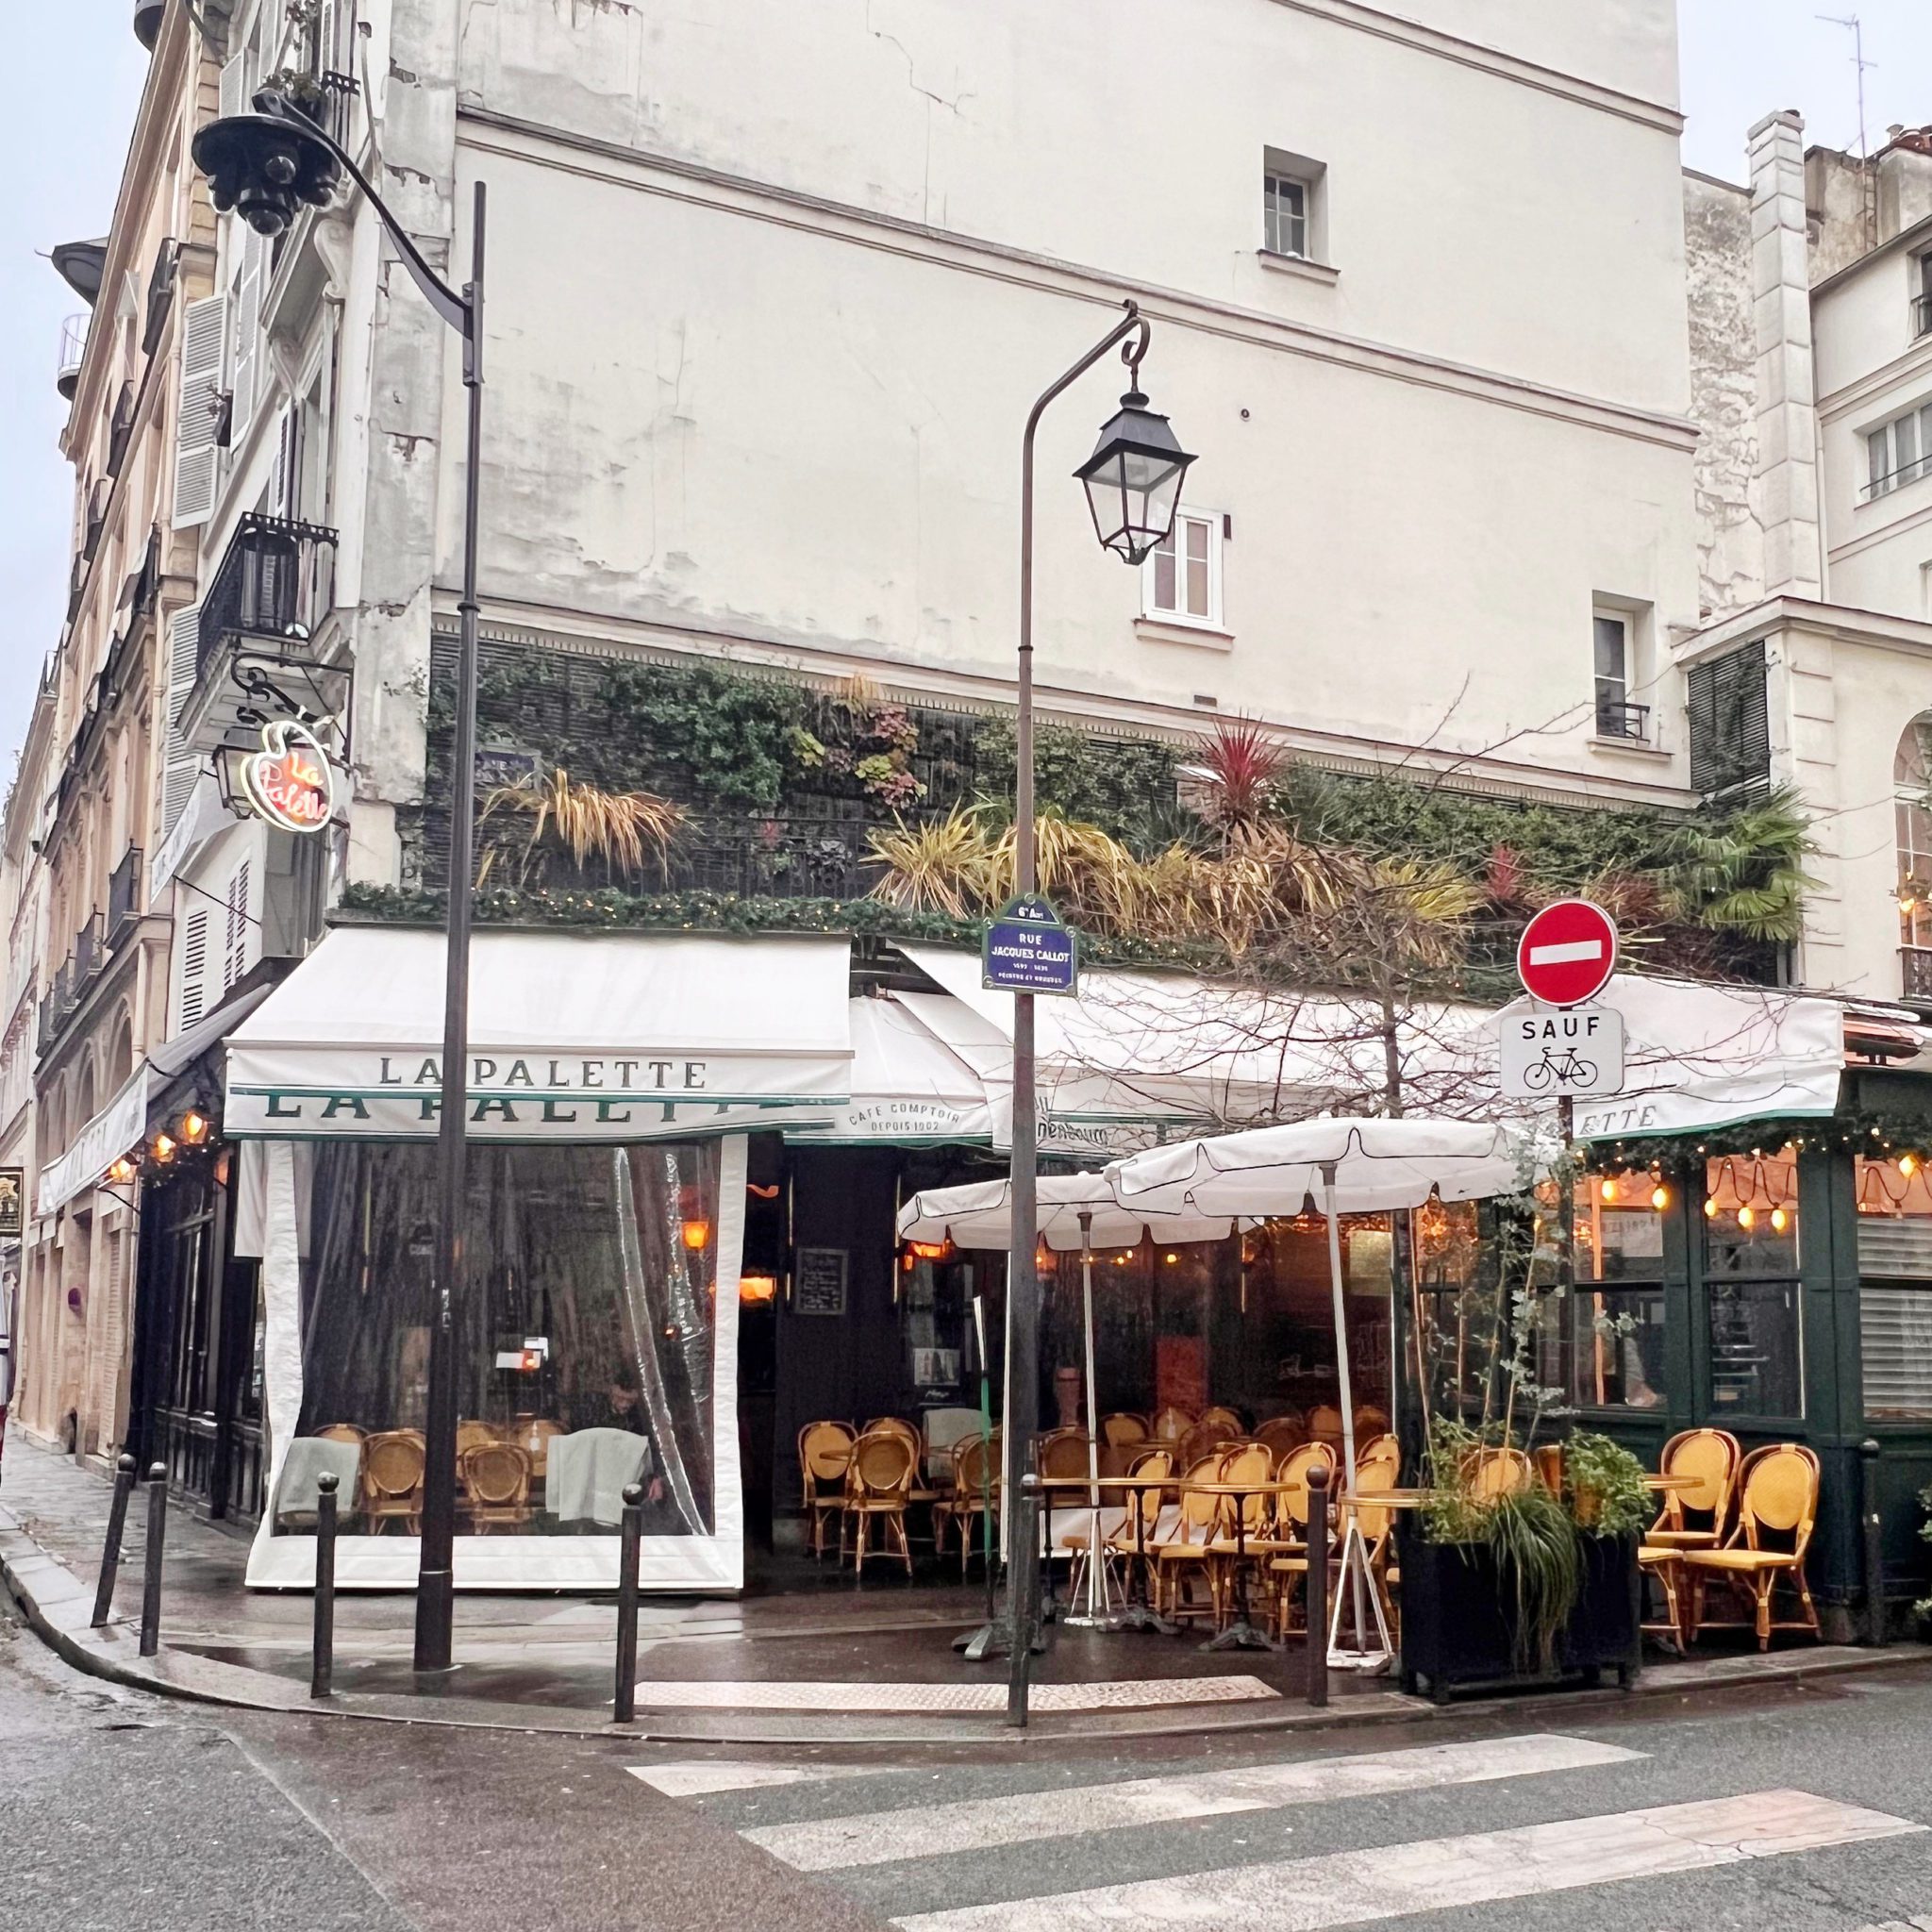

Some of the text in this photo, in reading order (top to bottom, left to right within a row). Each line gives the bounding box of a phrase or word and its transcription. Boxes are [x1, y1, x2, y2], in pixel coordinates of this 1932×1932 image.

[1019, 933, 1042, 945] RUE
[991, 946, 1071, 962] JACQUES CALLOT
[1522, 1016, 1600, 1040] SAUF
[379, 1057, 707, 1089] LA PALETTE
[890, 1103, 960, 1124] COMPTOIR
[871, 1121, 940, 1132] DEPUIS 1902
